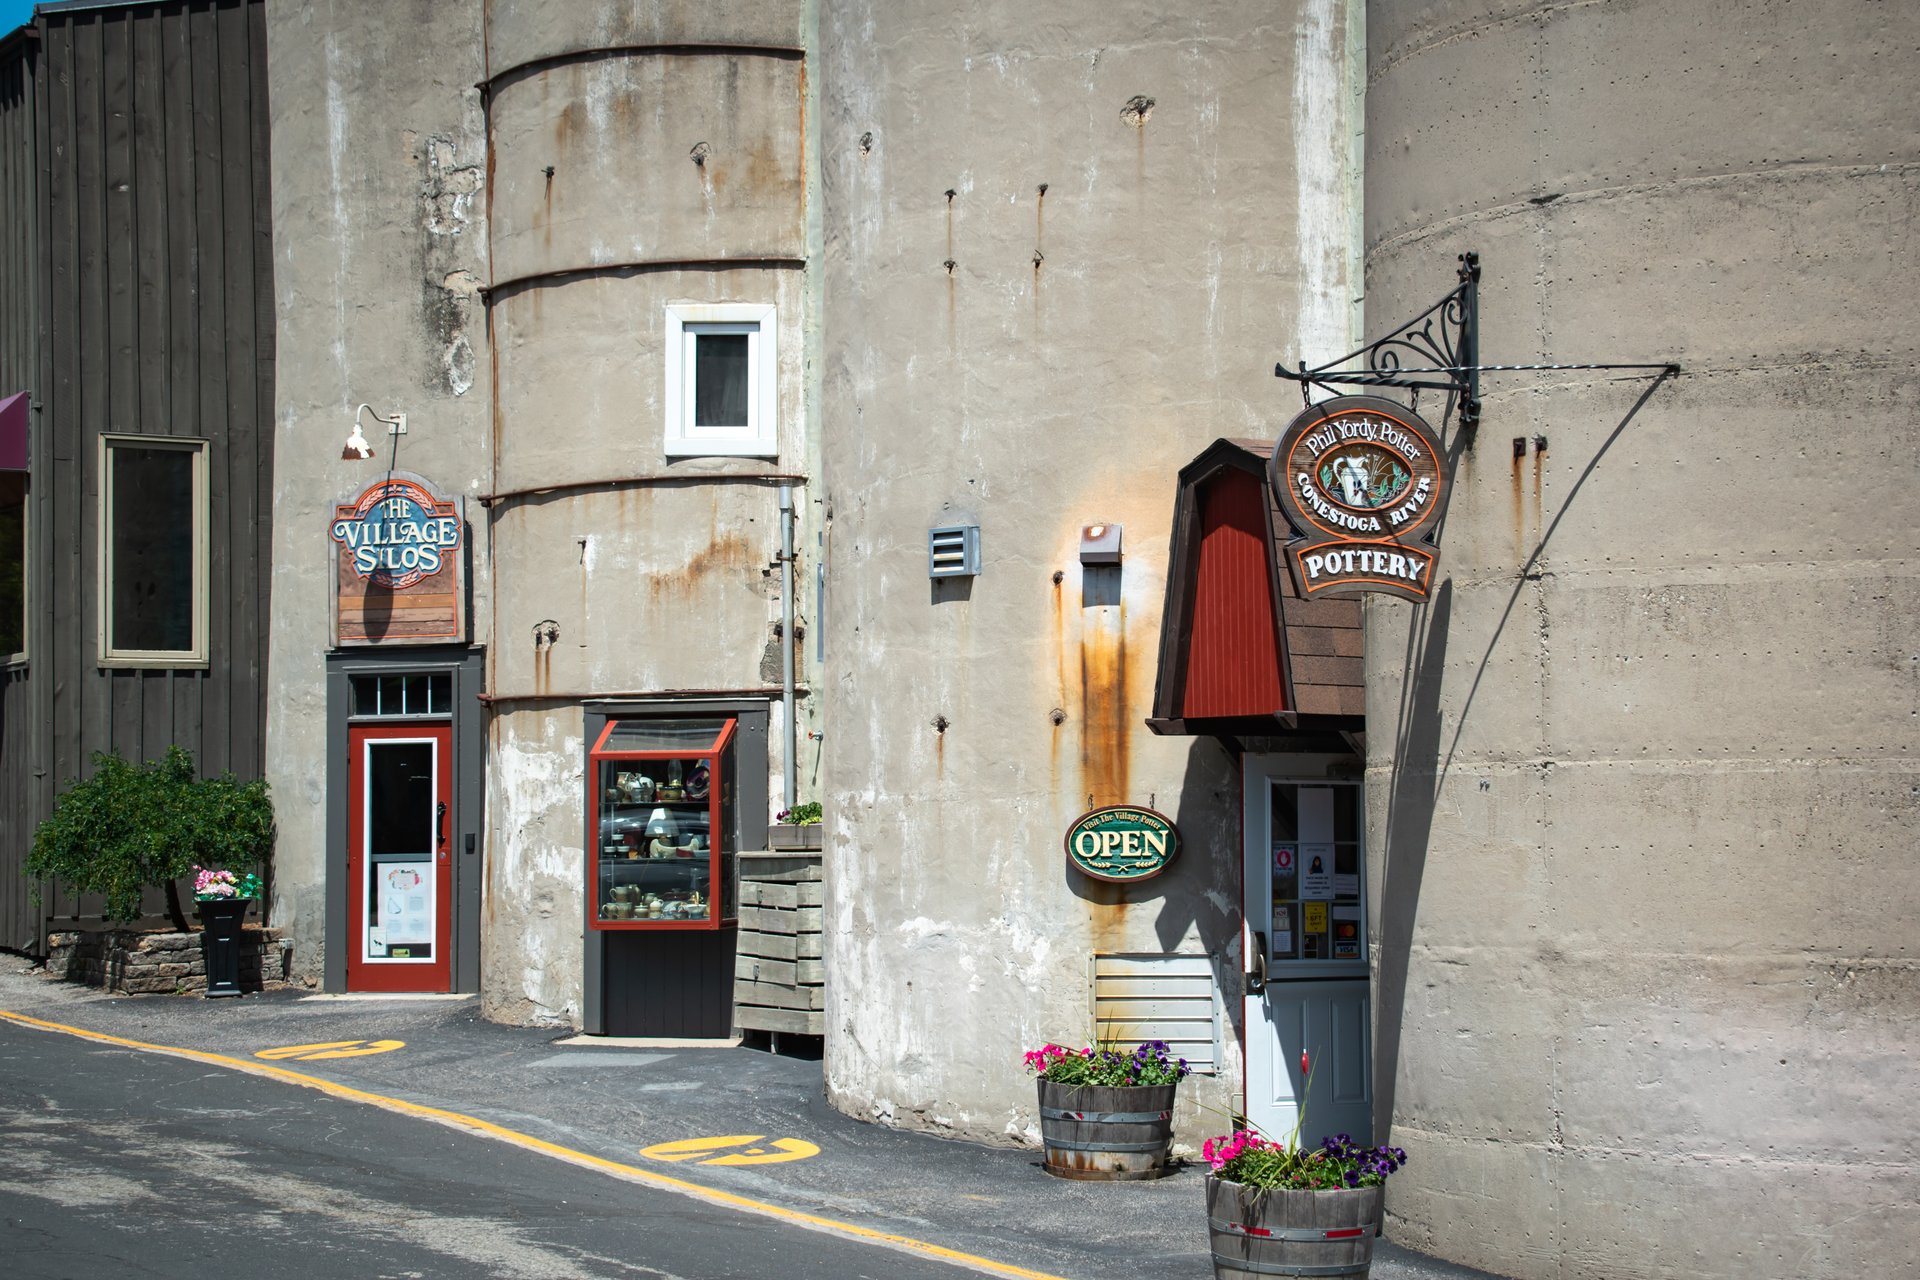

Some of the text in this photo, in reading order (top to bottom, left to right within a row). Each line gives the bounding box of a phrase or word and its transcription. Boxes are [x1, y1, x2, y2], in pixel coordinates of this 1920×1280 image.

[1306, 425, 1337, 457] Phil
[1380, 421, 1421, 461] Potter
[379, 498, 412, 519] THE
[1298, 473, 1431, 531] CONESTOGA RIVER
[334, 518, 457, 548] VILLAGE
[356, 543, 439, 572] SILOS
[1305, 550, 1424, 581] POTTERY
[1083, 812, 1161, 830] Visit The Village Potter
[1075, 829, 1169, 858] OPEN
